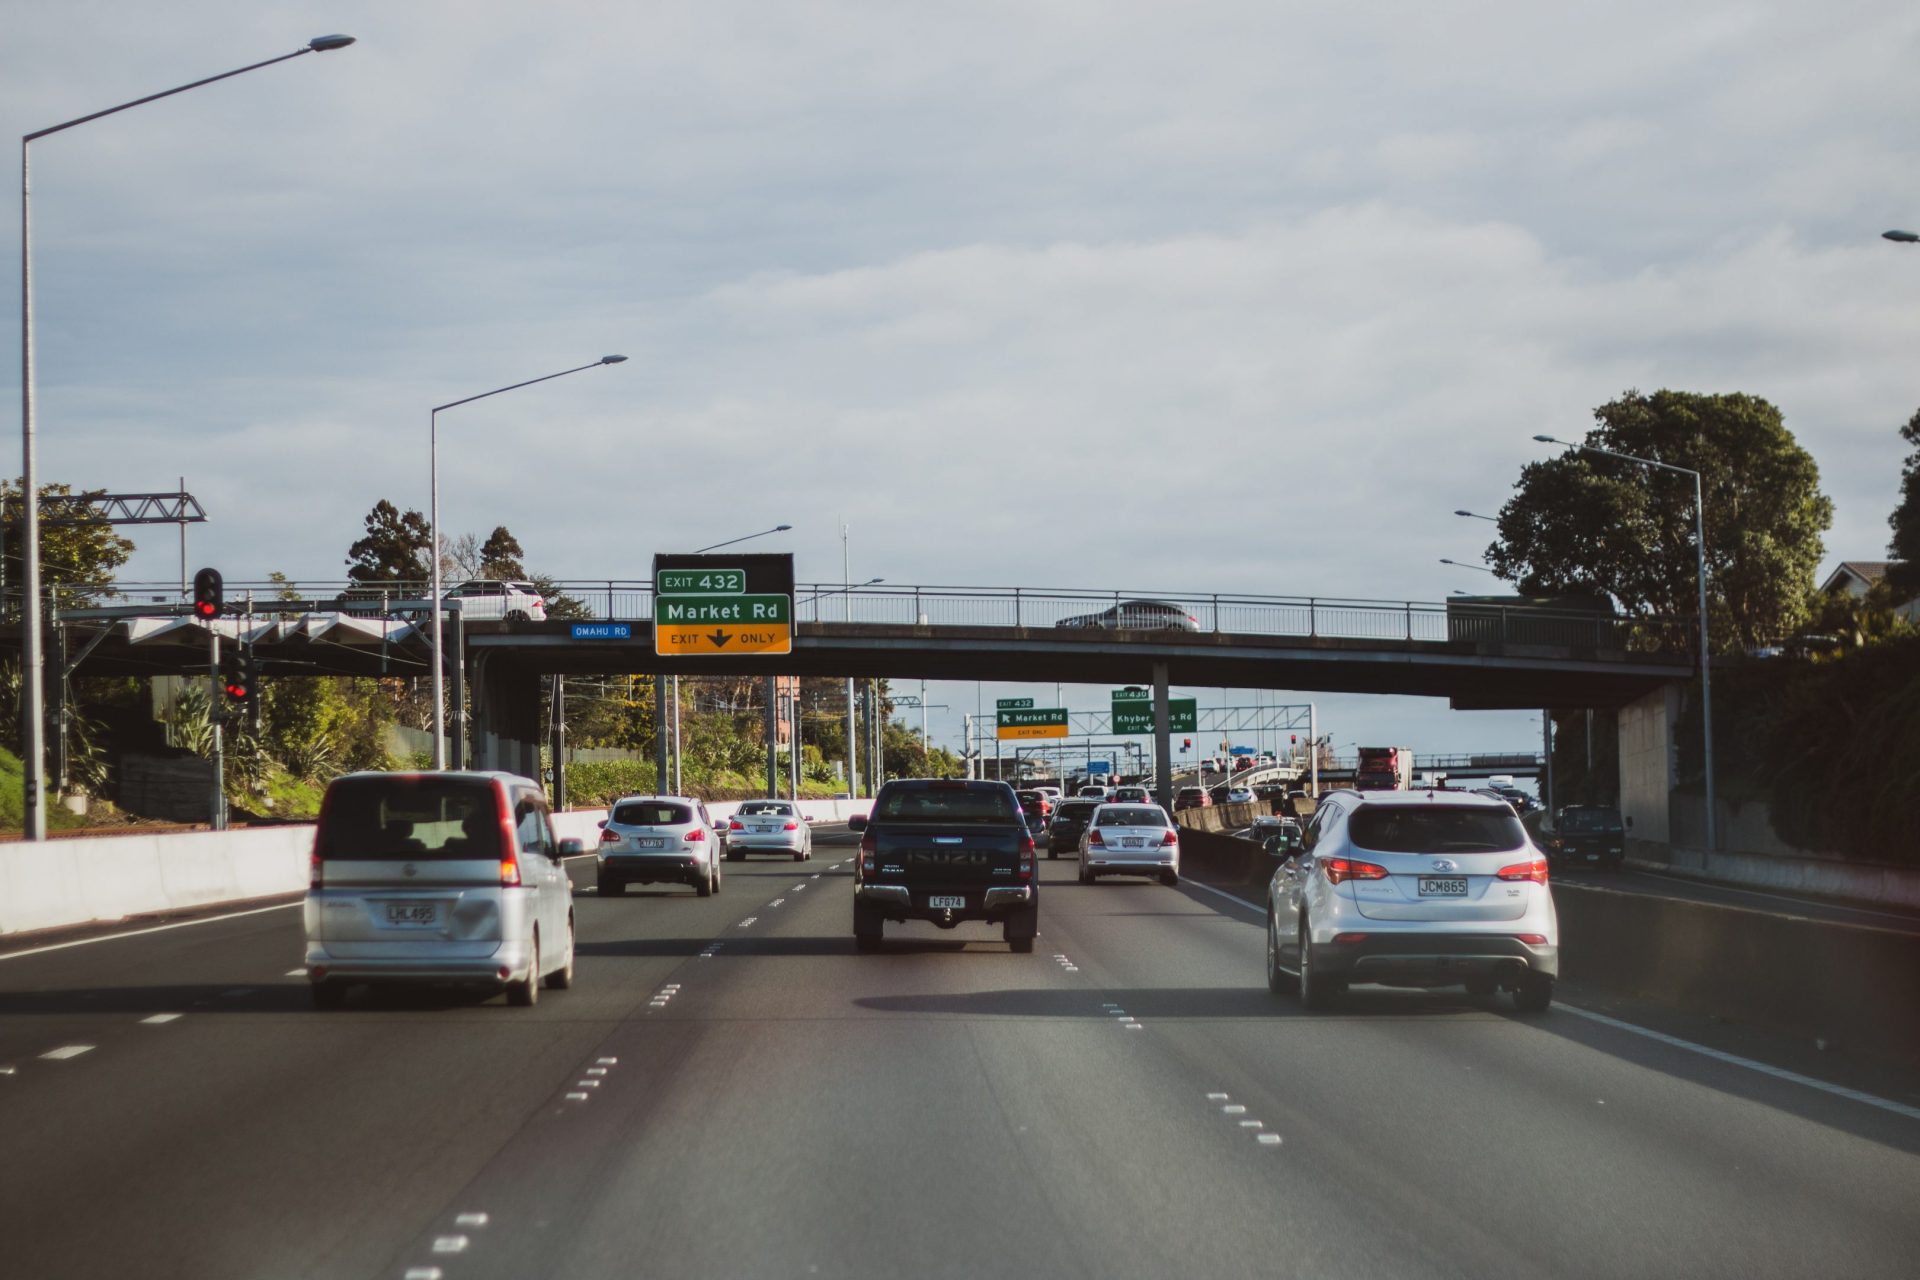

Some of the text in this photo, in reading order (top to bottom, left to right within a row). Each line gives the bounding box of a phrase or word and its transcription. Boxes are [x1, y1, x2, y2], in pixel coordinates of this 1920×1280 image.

[665, 575, 738, 589] EXIT 432
[668, 603, 777, 619] Market Rd
[576, 627, 627, 636] OMAHU RD
[671, 633, 776, 644] EXIT ONLY
[1015, 714, 1047, 722] Market
[1117, 715, 1150, 723] Khyber
[907, 849, 988, 864] ISUZU
[1421, 881, 1466, 892] JCM865
